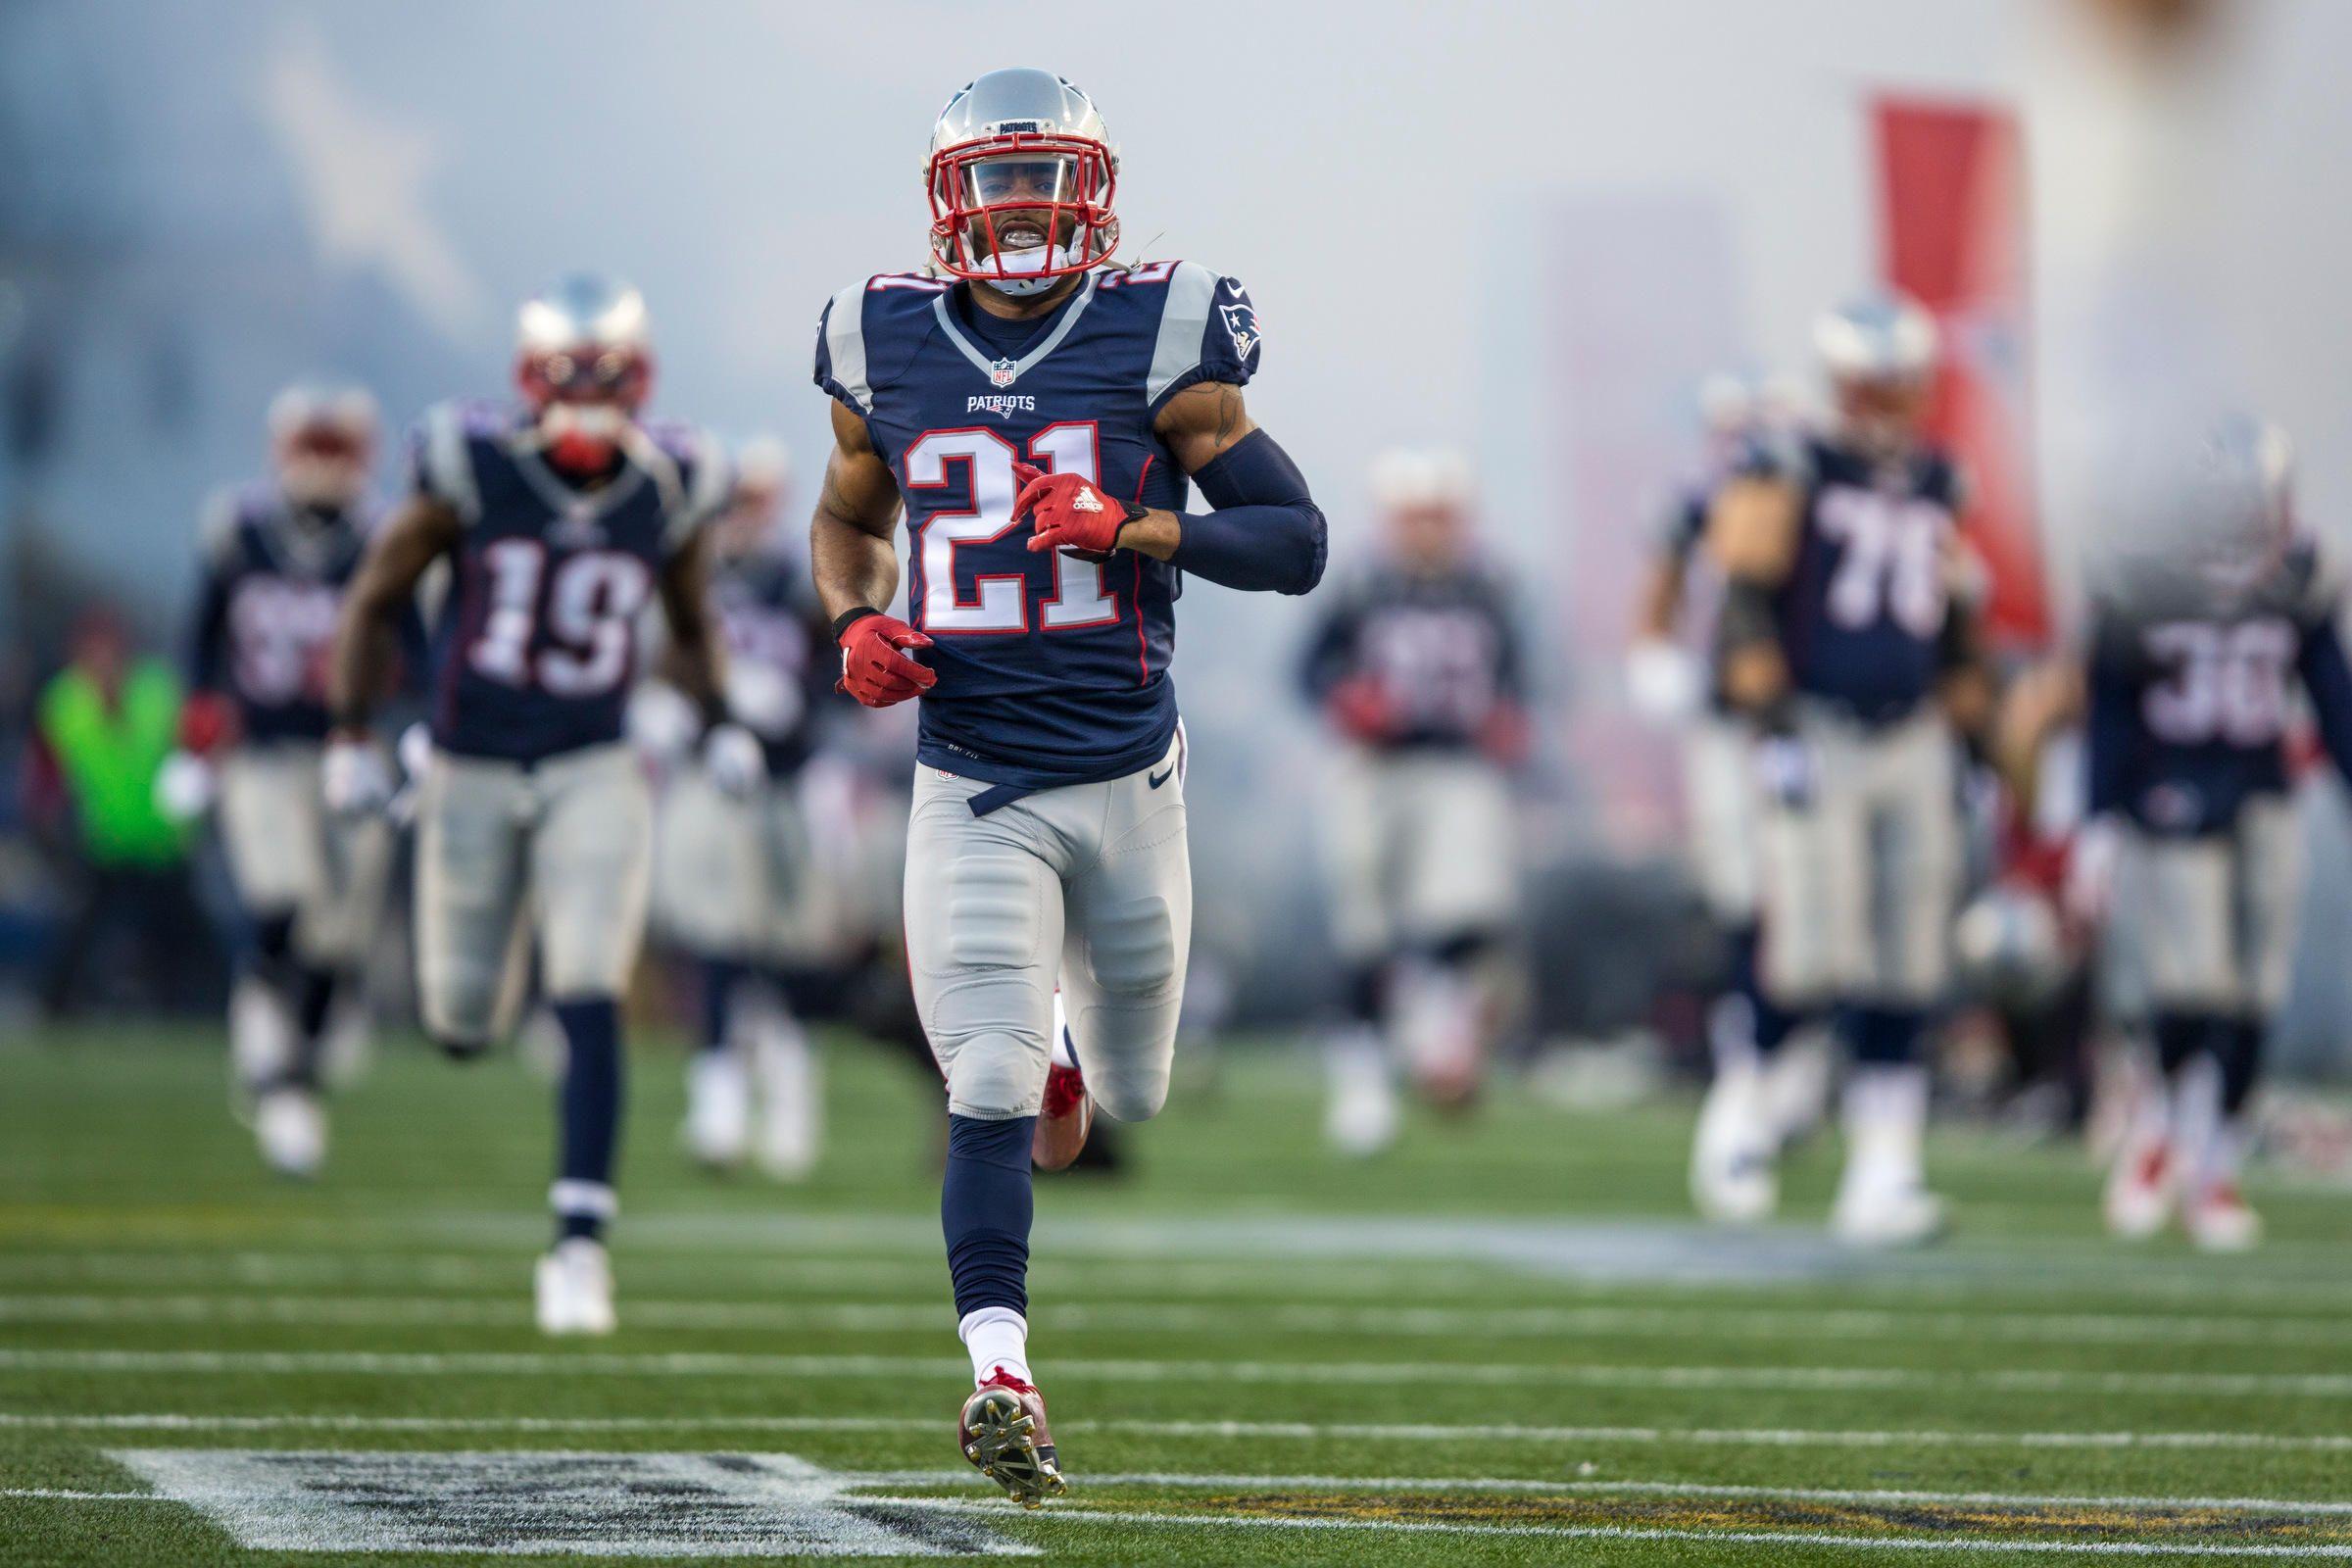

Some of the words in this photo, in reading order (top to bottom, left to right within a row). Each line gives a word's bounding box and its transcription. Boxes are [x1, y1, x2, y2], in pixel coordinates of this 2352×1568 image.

[1000, 122, 1037, 135] PATRIOTS
[994, 370, 1012, 383] NFL
[967, 395, 1035, 413] PATRIOTS
[904, 420, 1119, 634] 21
[466, 539, 651, 697] 19
